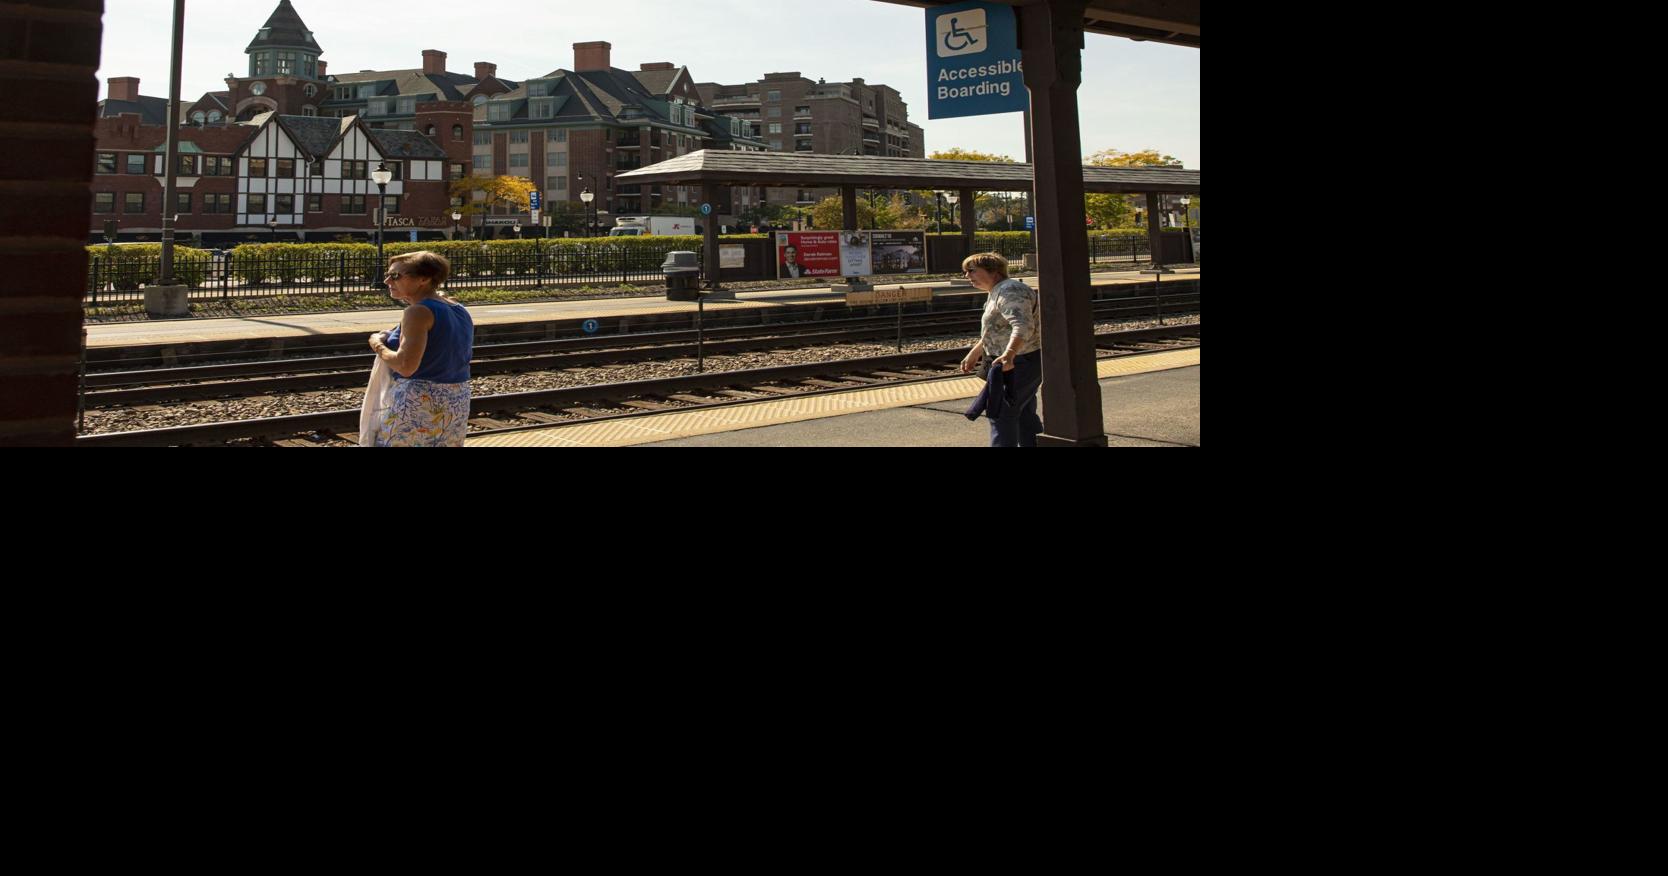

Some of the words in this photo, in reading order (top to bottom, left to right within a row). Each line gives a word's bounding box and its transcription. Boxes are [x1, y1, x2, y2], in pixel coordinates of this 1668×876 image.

[937, 58, 1023, 82] Accessible
[937, 80, 1011, 100] Boarding
[386, 216, 415, 226] TASCA
[875, 290, 907, 299] DANGER
